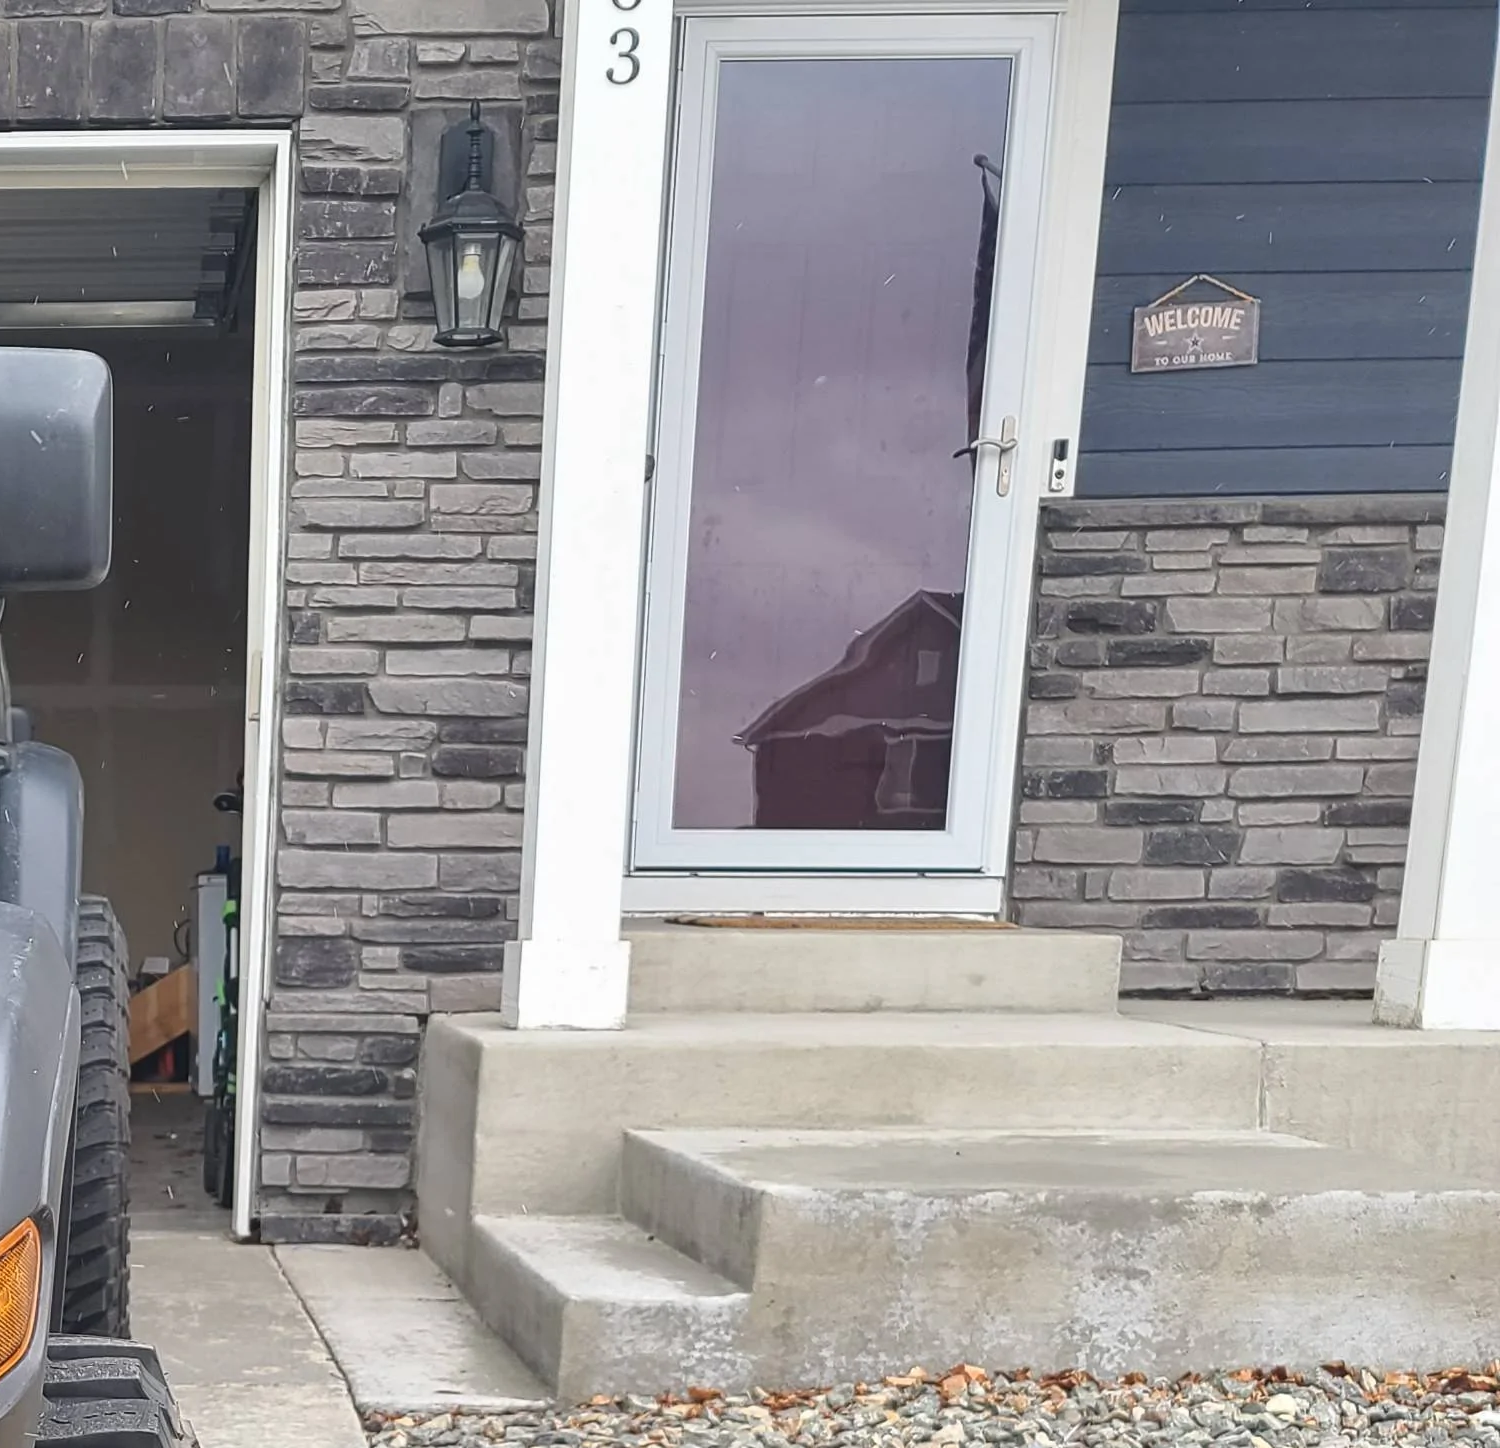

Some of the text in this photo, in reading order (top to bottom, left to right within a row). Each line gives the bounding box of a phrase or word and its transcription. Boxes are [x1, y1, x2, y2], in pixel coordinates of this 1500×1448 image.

[606, 0, 642, 85] 3
[1144, 305, 1245, 337] WELCOME
[1154, 351, 1234, 366] TO OUR HOME
